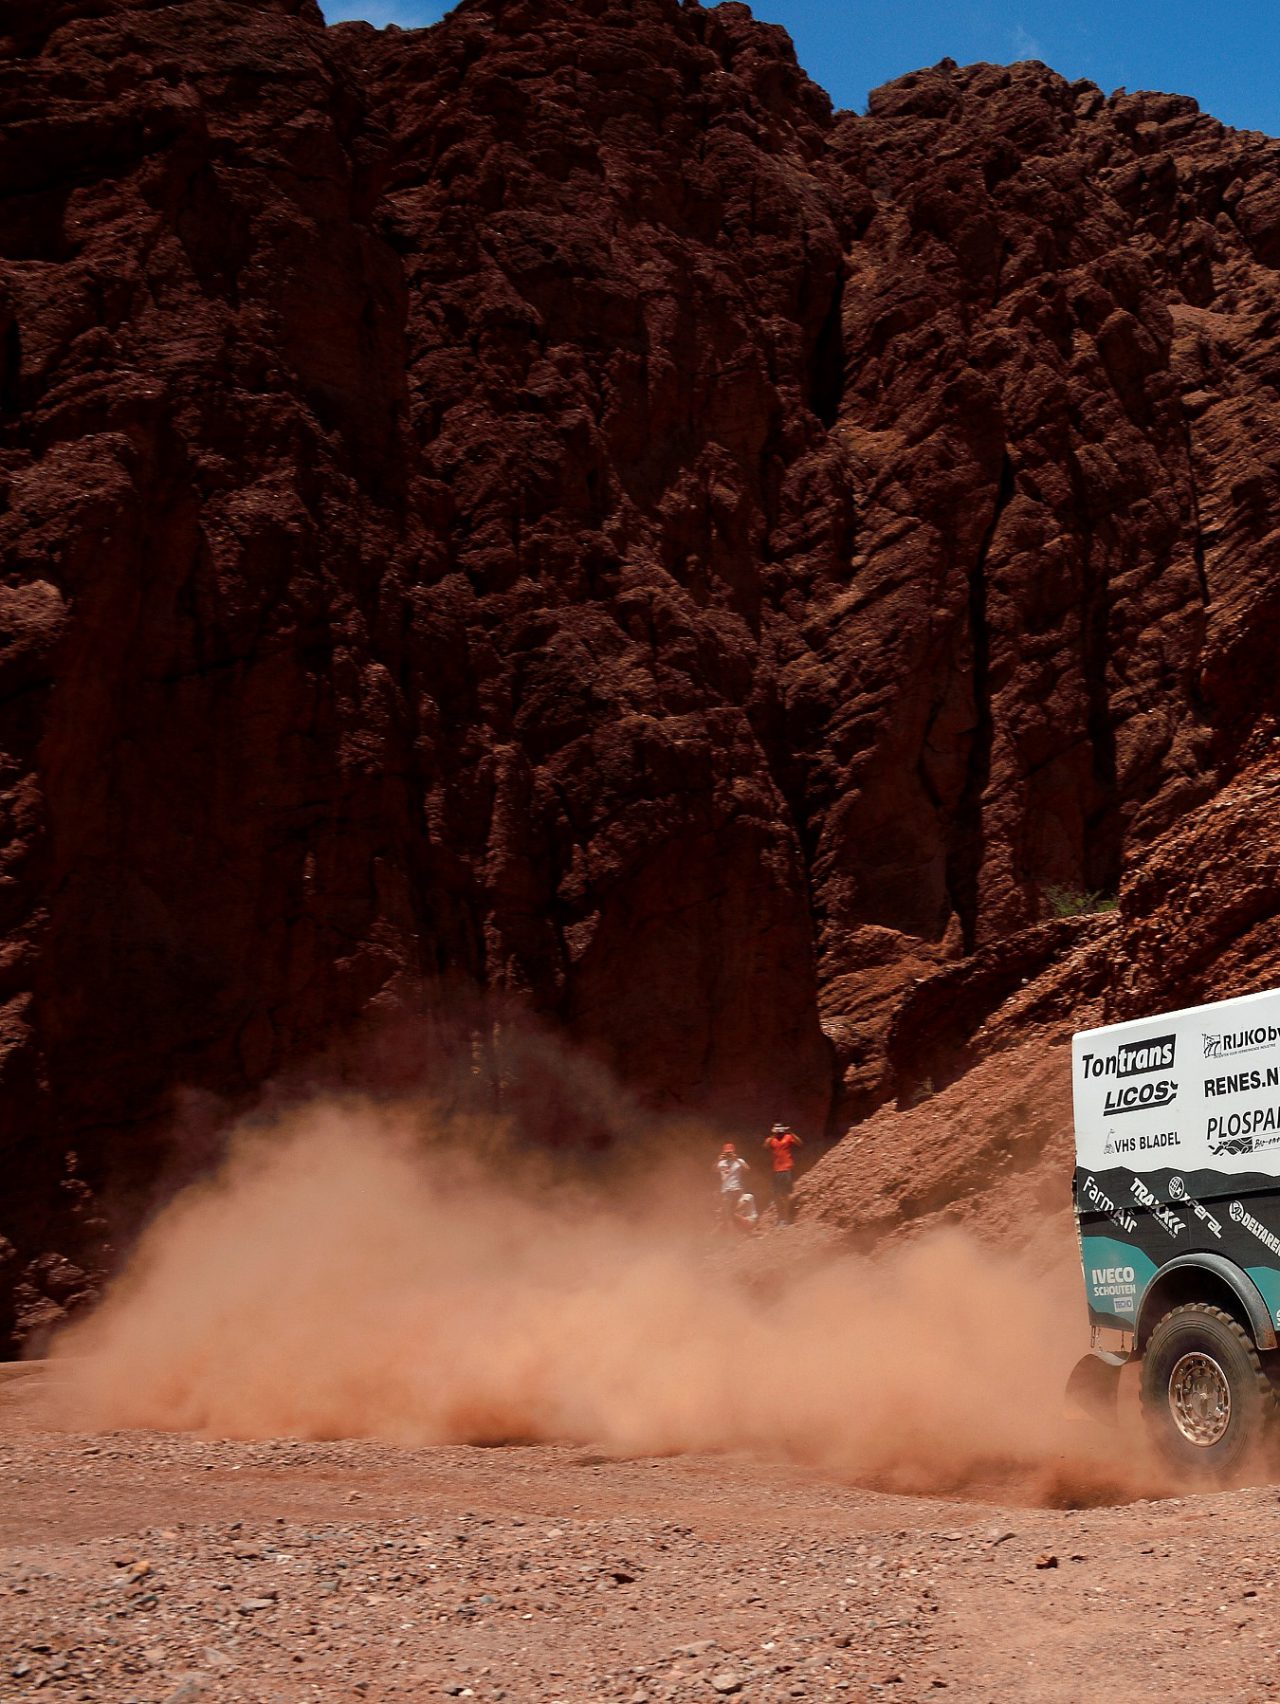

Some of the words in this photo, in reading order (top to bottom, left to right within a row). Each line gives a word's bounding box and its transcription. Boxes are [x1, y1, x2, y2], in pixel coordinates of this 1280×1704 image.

[1082, 1042, 1174, 1079] Tontrans
[1104, 1083, 1170, 1109] LICOS
[1114, 1137, 1137, 1154] VHS
[1140, 1131, 1181, 1150] BLADEL
[1091, 1267, 1135, 1285] IVECO
[1094, 1284, 1136, 1297] SCHOUTEN
